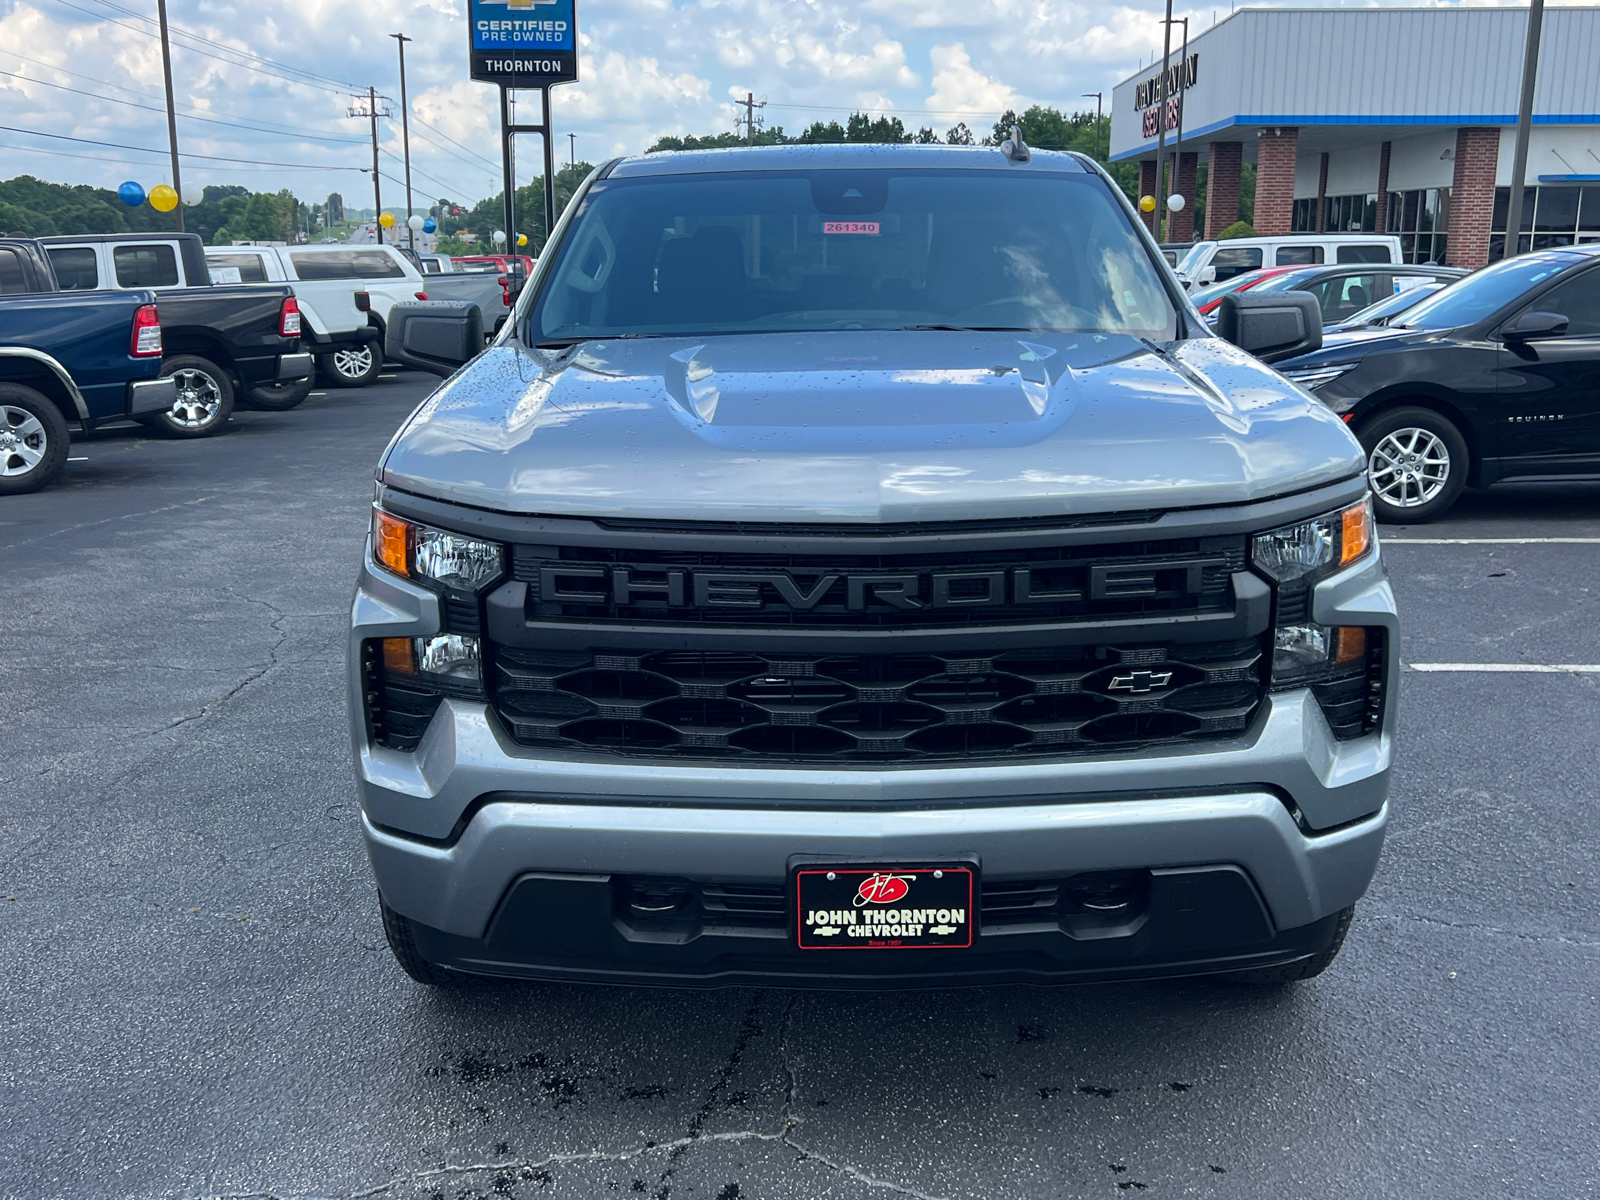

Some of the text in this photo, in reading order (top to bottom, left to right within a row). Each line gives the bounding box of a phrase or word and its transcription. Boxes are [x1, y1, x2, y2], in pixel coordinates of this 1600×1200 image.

[477, 20, 567, 31] CERTIFIED
[482, 32, 563, 41] PRE-OWNED
[485, 60, 561, 72] THORNTON
[826, 223, 876, 232] 261340
[1508, 414, 1564, 422] EQUINOX
[539, 556, 1226, 611] CHEVROLET
[806, 909, 965, 925] JOHN THORNTON
[847, 924, 923, 937] CHEVROLET
